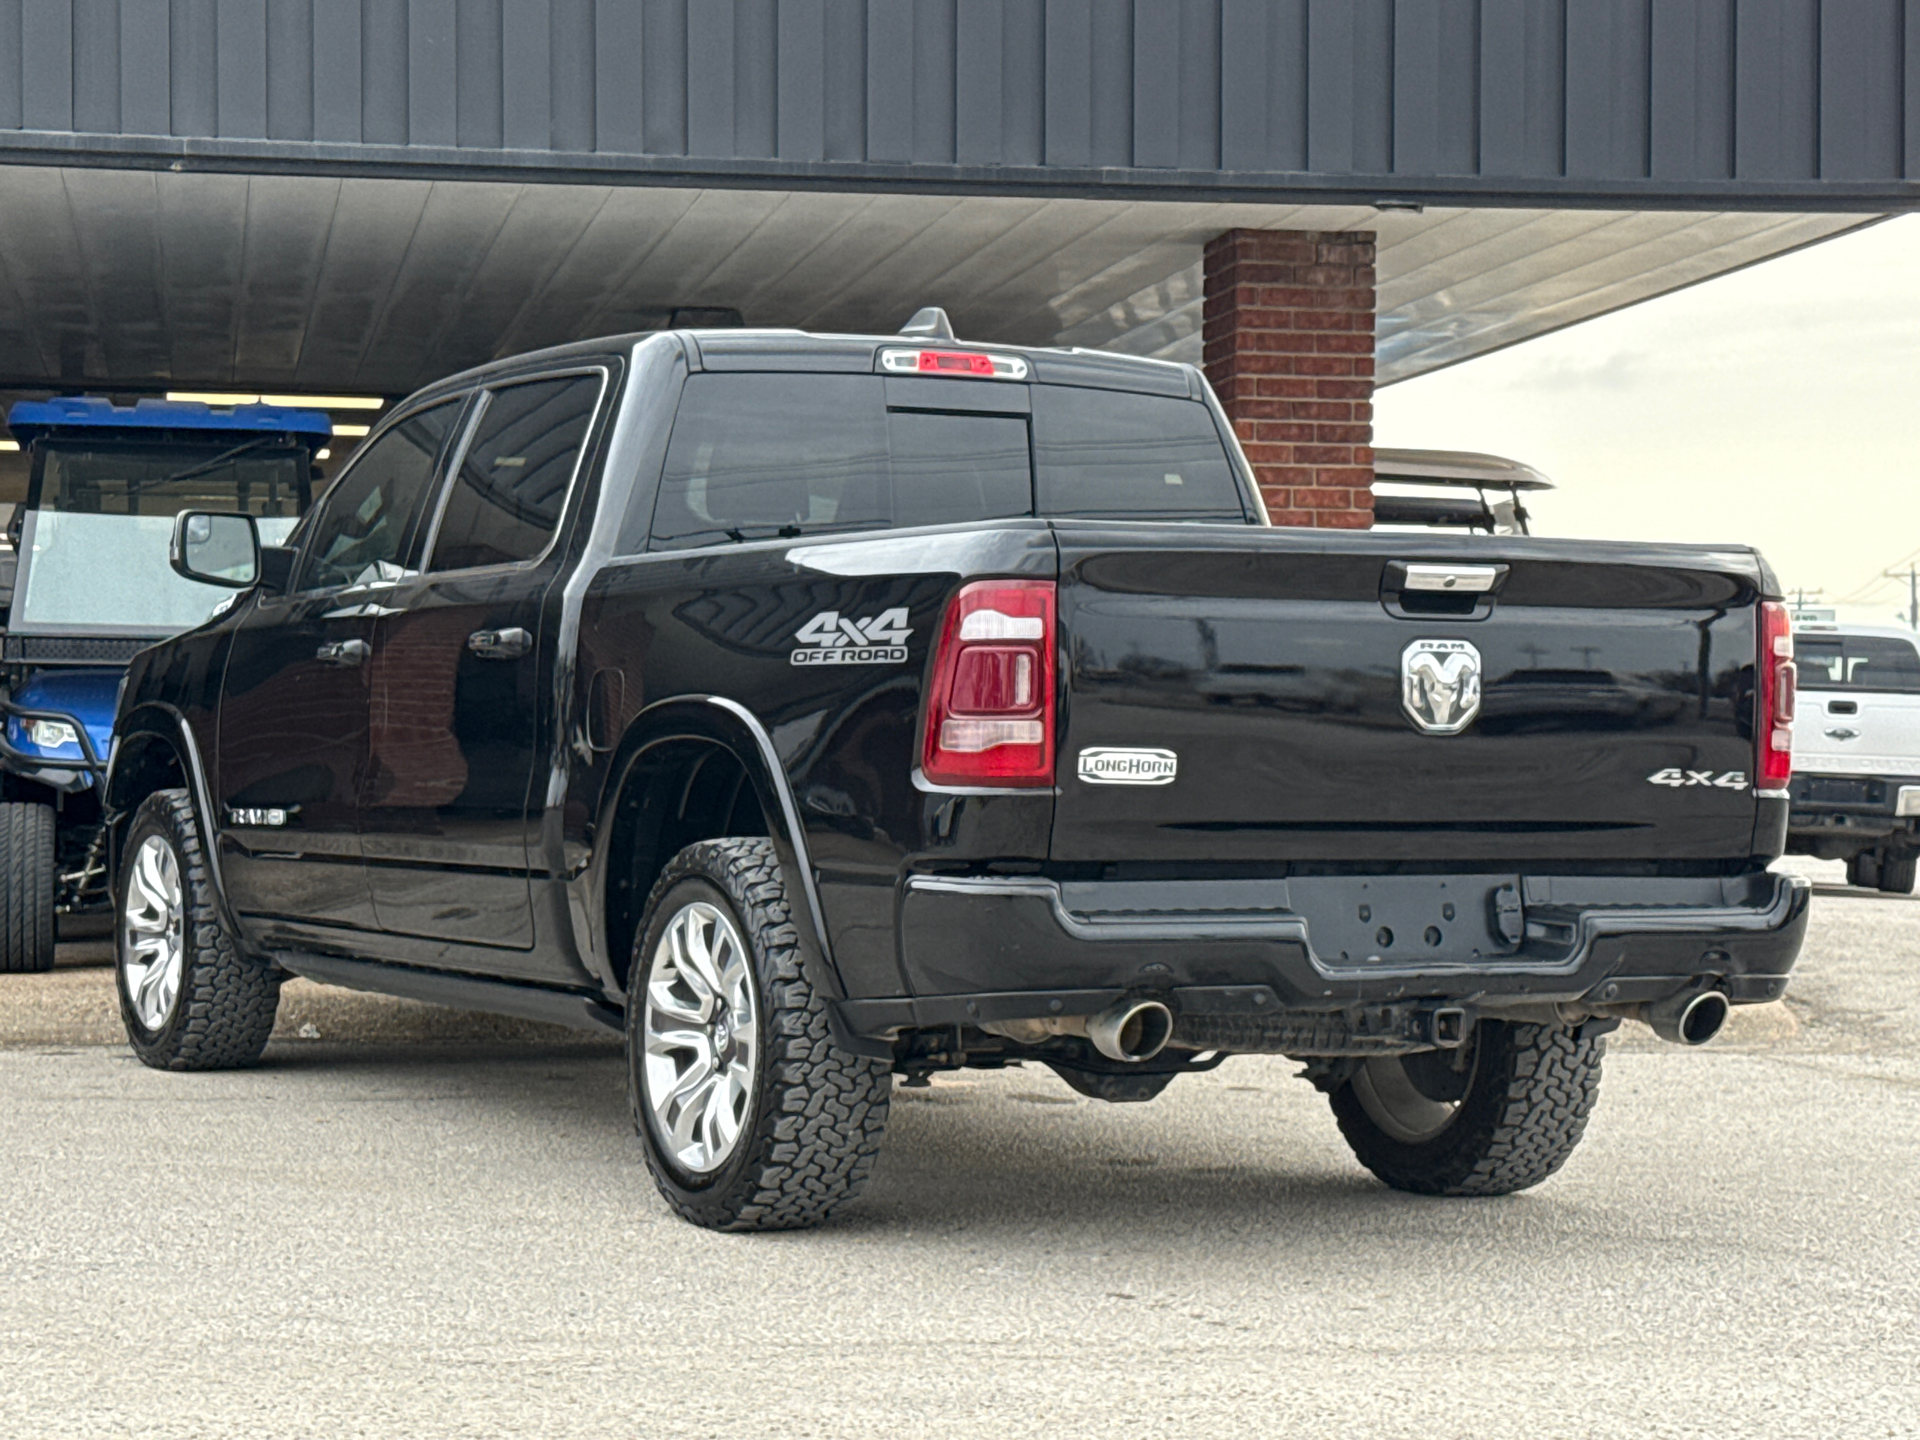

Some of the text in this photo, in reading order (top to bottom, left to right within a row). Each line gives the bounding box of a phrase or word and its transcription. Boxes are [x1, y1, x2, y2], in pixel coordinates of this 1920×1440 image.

[1419, 642, 1465, 650] RAM
[793, 648, 906, 663] OFF ROAD
[1081, 757, 1175, 775] LONGHORN
